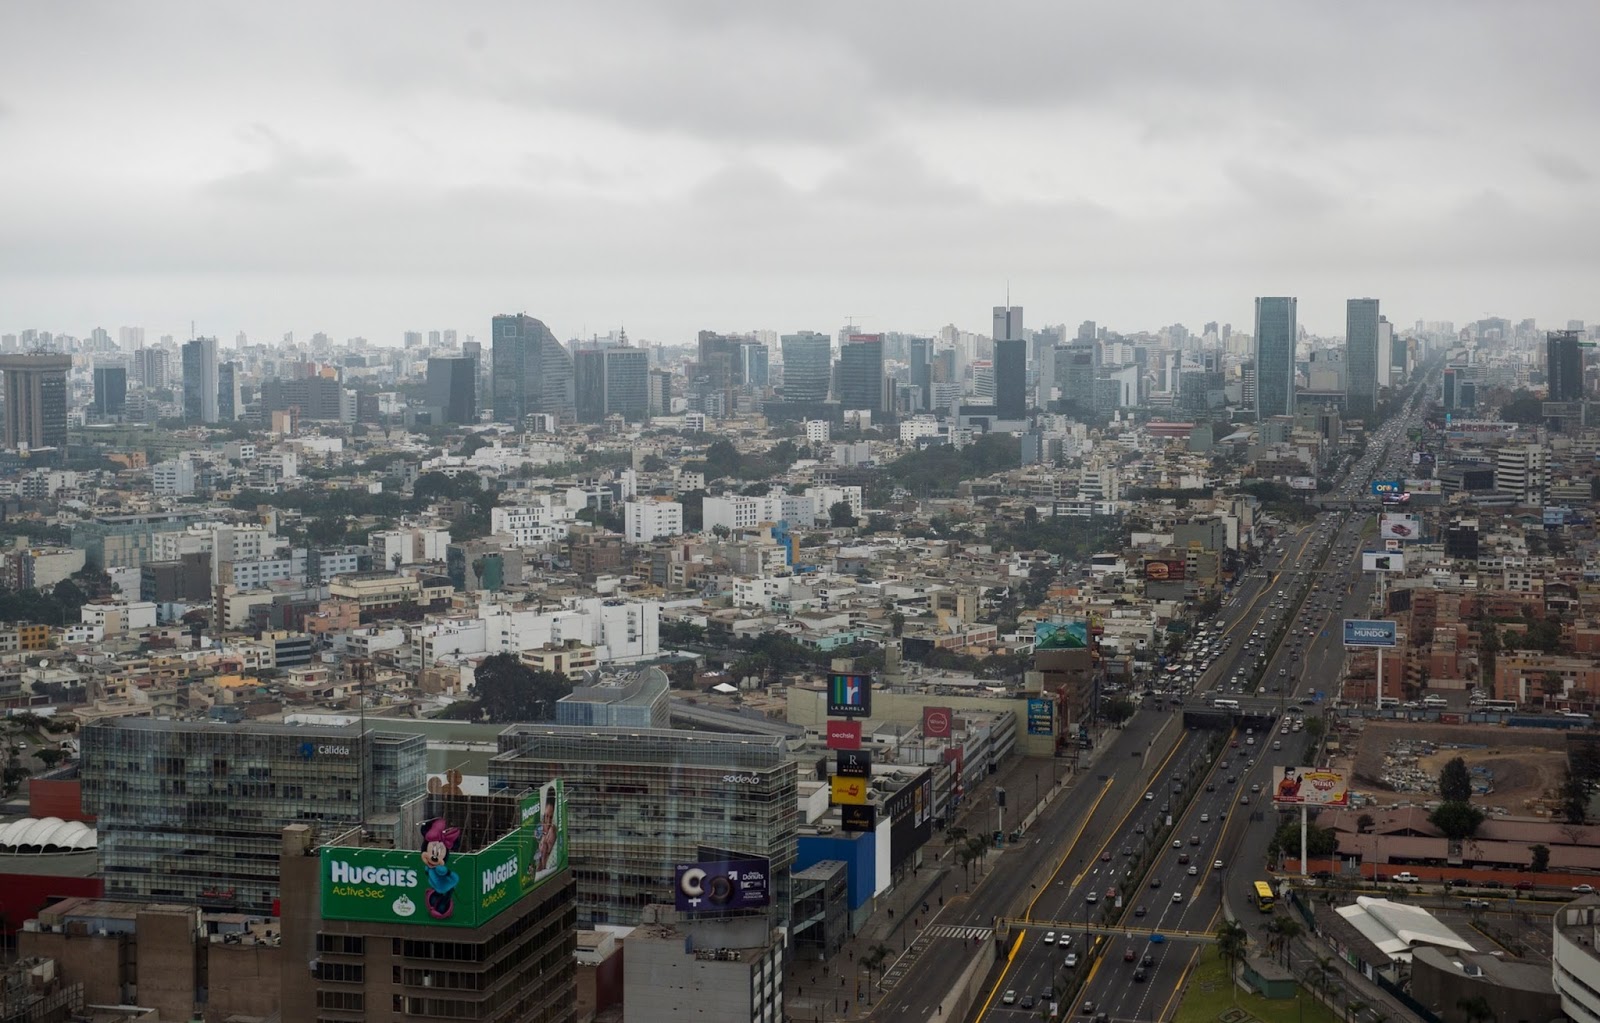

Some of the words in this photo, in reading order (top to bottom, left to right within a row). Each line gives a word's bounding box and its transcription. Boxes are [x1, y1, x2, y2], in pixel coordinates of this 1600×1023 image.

[1354, 630, 1385, 638] MUNDO
[832, 732, 854, 740] oechsle
[318, 745, 350, 755] Cálidda
[722, 774, 760, 785] sodexo
[331, 860, 418, 888] HUGGIES
[482, 856, 518, 895] HUGGIES
